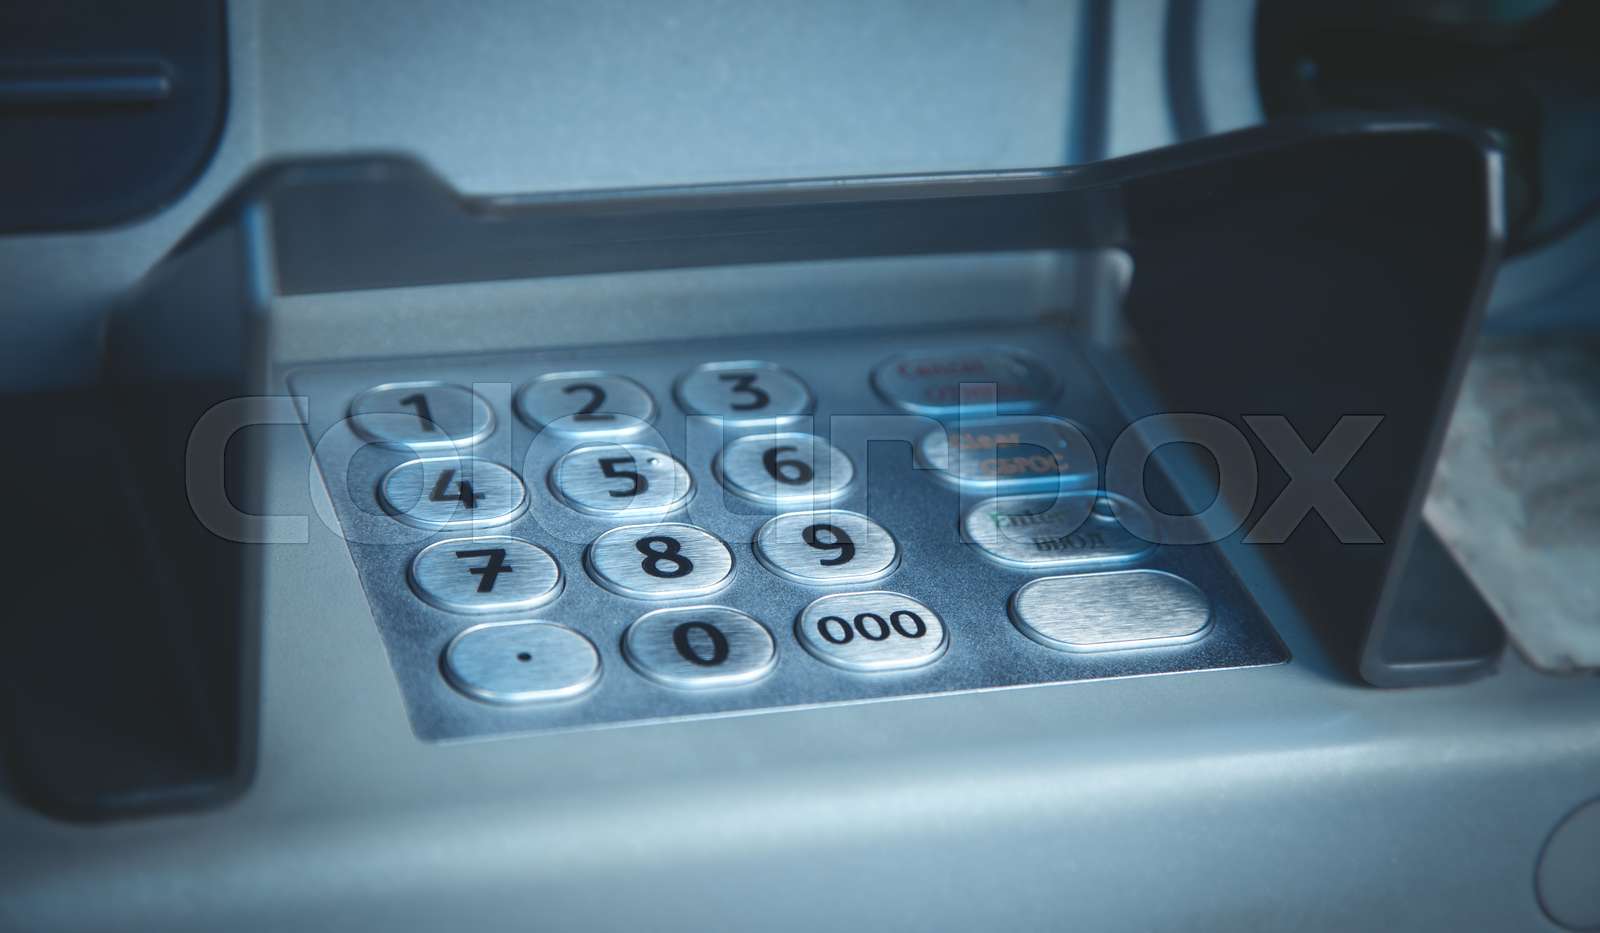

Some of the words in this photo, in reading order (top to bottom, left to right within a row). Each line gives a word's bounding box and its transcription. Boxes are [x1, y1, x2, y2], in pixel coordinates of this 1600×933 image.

[562, 383, 618, 422] 2
[718, 372, 770, 412] 3
[400, 393, 436, 432] 1
[598, 457, 649, 497] 5
[762, 446, 815, 486] 6
[428, 469, 486, 509] 4
[635, 535, 694, 579] 8
[802, 524, 856, 567] 9
[455, 548, 513, 593] 7
[672, 621, 730, 667] 0
[817, 610, 927, 645] 000
